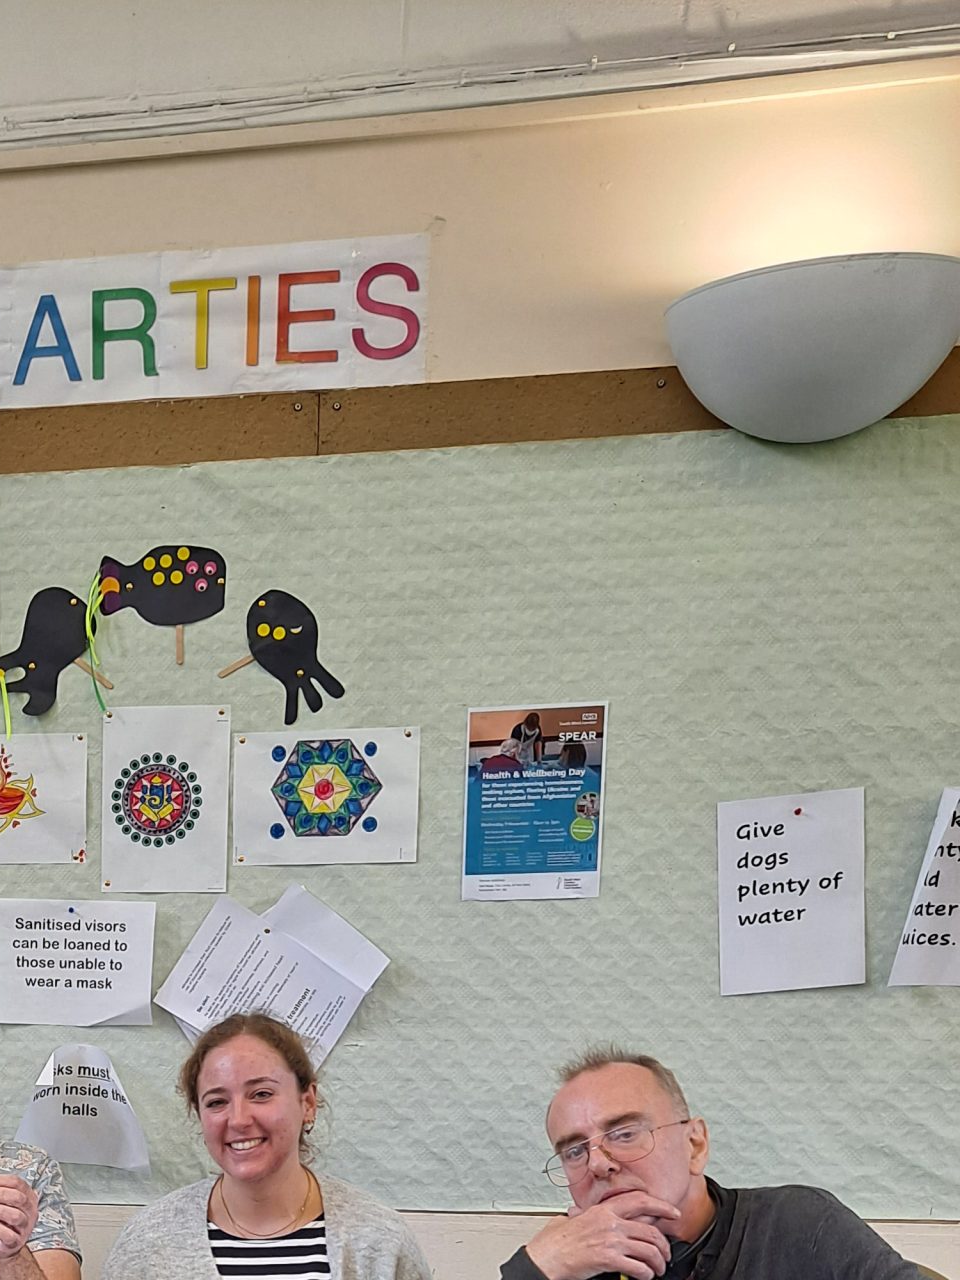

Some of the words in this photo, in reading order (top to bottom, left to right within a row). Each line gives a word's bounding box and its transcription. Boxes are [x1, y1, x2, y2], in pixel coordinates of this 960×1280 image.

[558, 731, 597, 742] SPEAR
[482, 770, 511, 780] Health
[513, 770, 520, 778] &
[522, 768, 566, 778] Wellbeing
[568, 768, 586, 777] Day
[736, 821, 785, 841] Give
[737, 852, 789, 870] dogs
[737, 877, 810, 903] plenty
[818, 871, 844, 890] of
[15, 917, 81, 931] Sanitised
[85, 919, 127, 932] visors
[738, 907, 806, 927] water
[13, 939, 38, 949] can
[42, 937, 60, 949] be
[64, 938, 110, 951] loaned
[114, 939, 128, 951] to
[16, 956, 55, 968] those
[60, 957, 106, 970] unable
[110, 958, 123, 971] to
[25, 978, 60, 988] wear
[64, 979, 72, 988] a
[77, 977, 112, 989] mask
[65, 1083, 108, 1098] inside
[62, 1102, 98, 1117] halls
